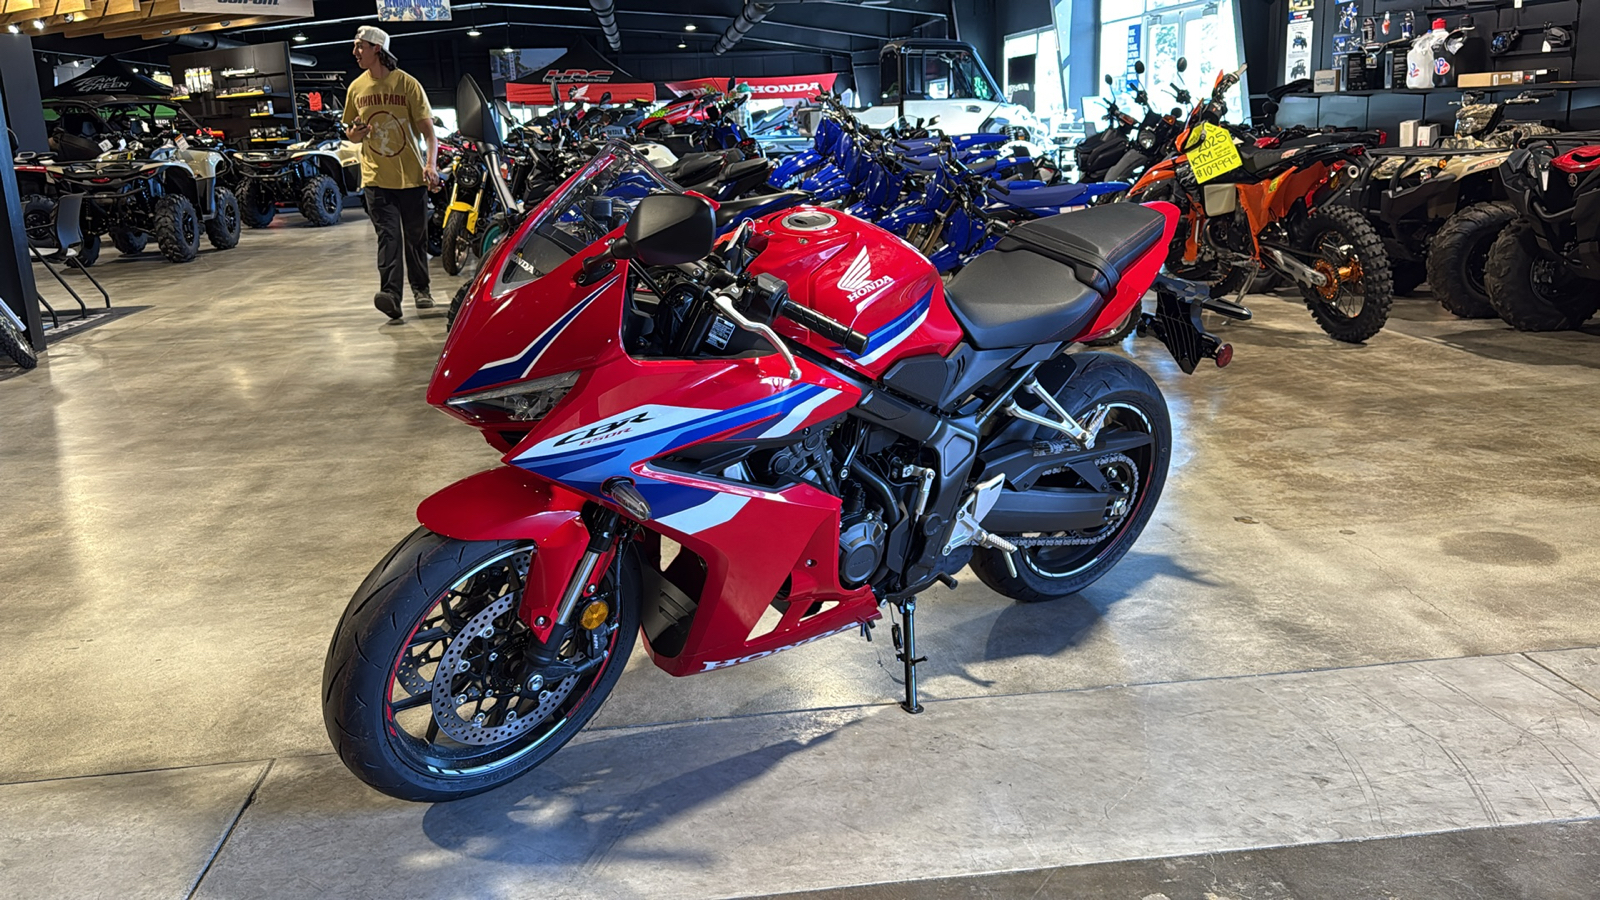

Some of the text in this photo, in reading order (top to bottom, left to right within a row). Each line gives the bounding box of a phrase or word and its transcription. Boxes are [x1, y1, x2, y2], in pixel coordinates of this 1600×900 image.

[542, 69, 614, 82] HRC
[77, 82, 129, 91] GREEN
[753, 82, 819, 93] HONDA
[383, 93, 407, 106] PARK
[1190, 151, 1213, 166] KTM
[846, 275, 894, 303] HONDA
[553, 411, 655, 448] CBR
[579, 427, 634, 446] 650R
[700, 621, 862, 673] HONDA
